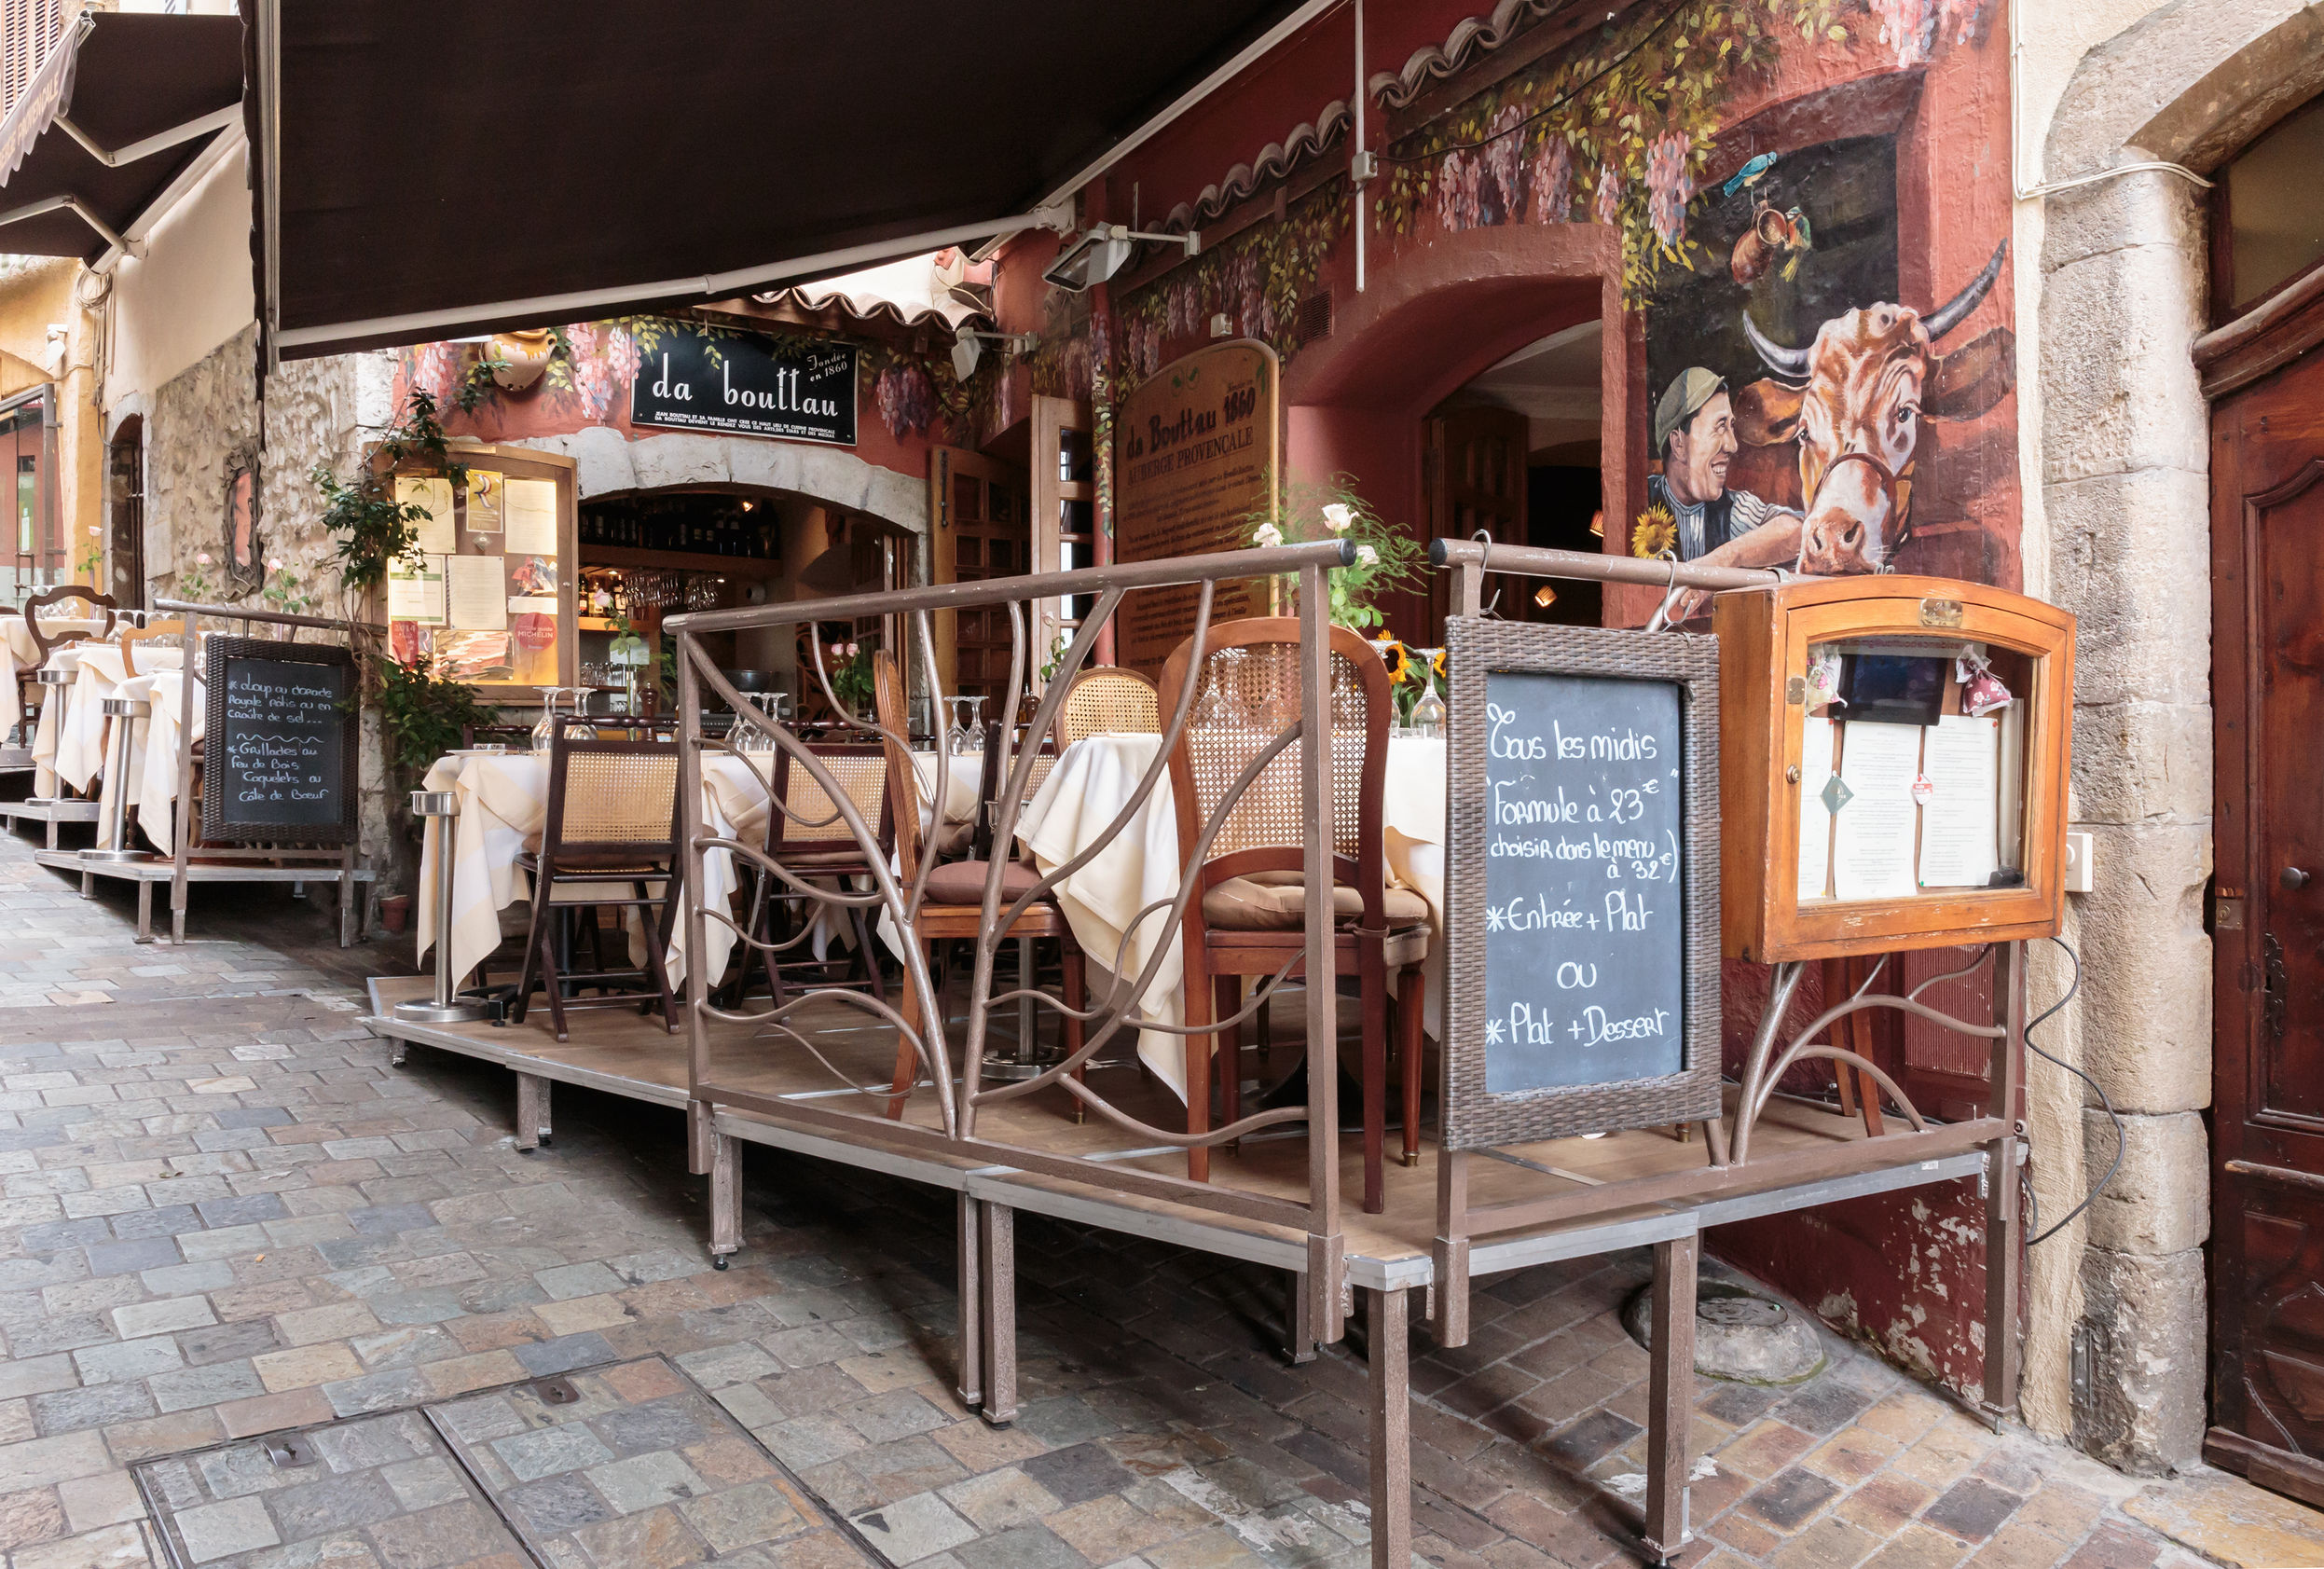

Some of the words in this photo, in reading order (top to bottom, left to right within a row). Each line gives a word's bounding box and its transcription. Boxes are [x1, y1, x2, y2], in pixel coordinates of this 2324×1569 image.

[809, 373, 822, 382] en
[824, 361, 847, 378] 1860
[652, 351, 693, 402] da
[723, 359, 838, 417] bouttau
[1126, 424, 1144, 461] da
[1148, 406, 1217, 455] Bouttau
[1223, 386, 1256, 428] 1860
[1127, 453, 1175, 487] AUBERGE
[517, 630, 554, 639] MICHELIN
[292, 684, 333, 698] dorade
[228, 695, 262, 709] Royale
[268, 712, 280, 722] de
[1486, 702, 1547, 760] Tous
[1553, 719, 1586, 761] les
[1590, 727, 1657, 762] midis
[239, 742, 297, 756] Grillades
[302, 748, 319, 756] au
[231, 755, 248, 769] feu
[252, 758, 266, 769] de
[270, 758, 299, 770] Bois
[242, 770, 299, 790] Coquelets
[239, 787, 265, 802] Côte
[269, 790, 283, 801] de
[1587, 784, 1603, 823] à
[1491, 832, 1553, 860] choisir
[1555, 834, 1591, 860] dans
[1593, 832, 1611, 859] le
[1612, 839, 1656, 860] menu
[1606, 857, 1622, 879] à
[1604, 890, 1654, 932] Plat
[1510, 1001, 1555, 1044] Plat
